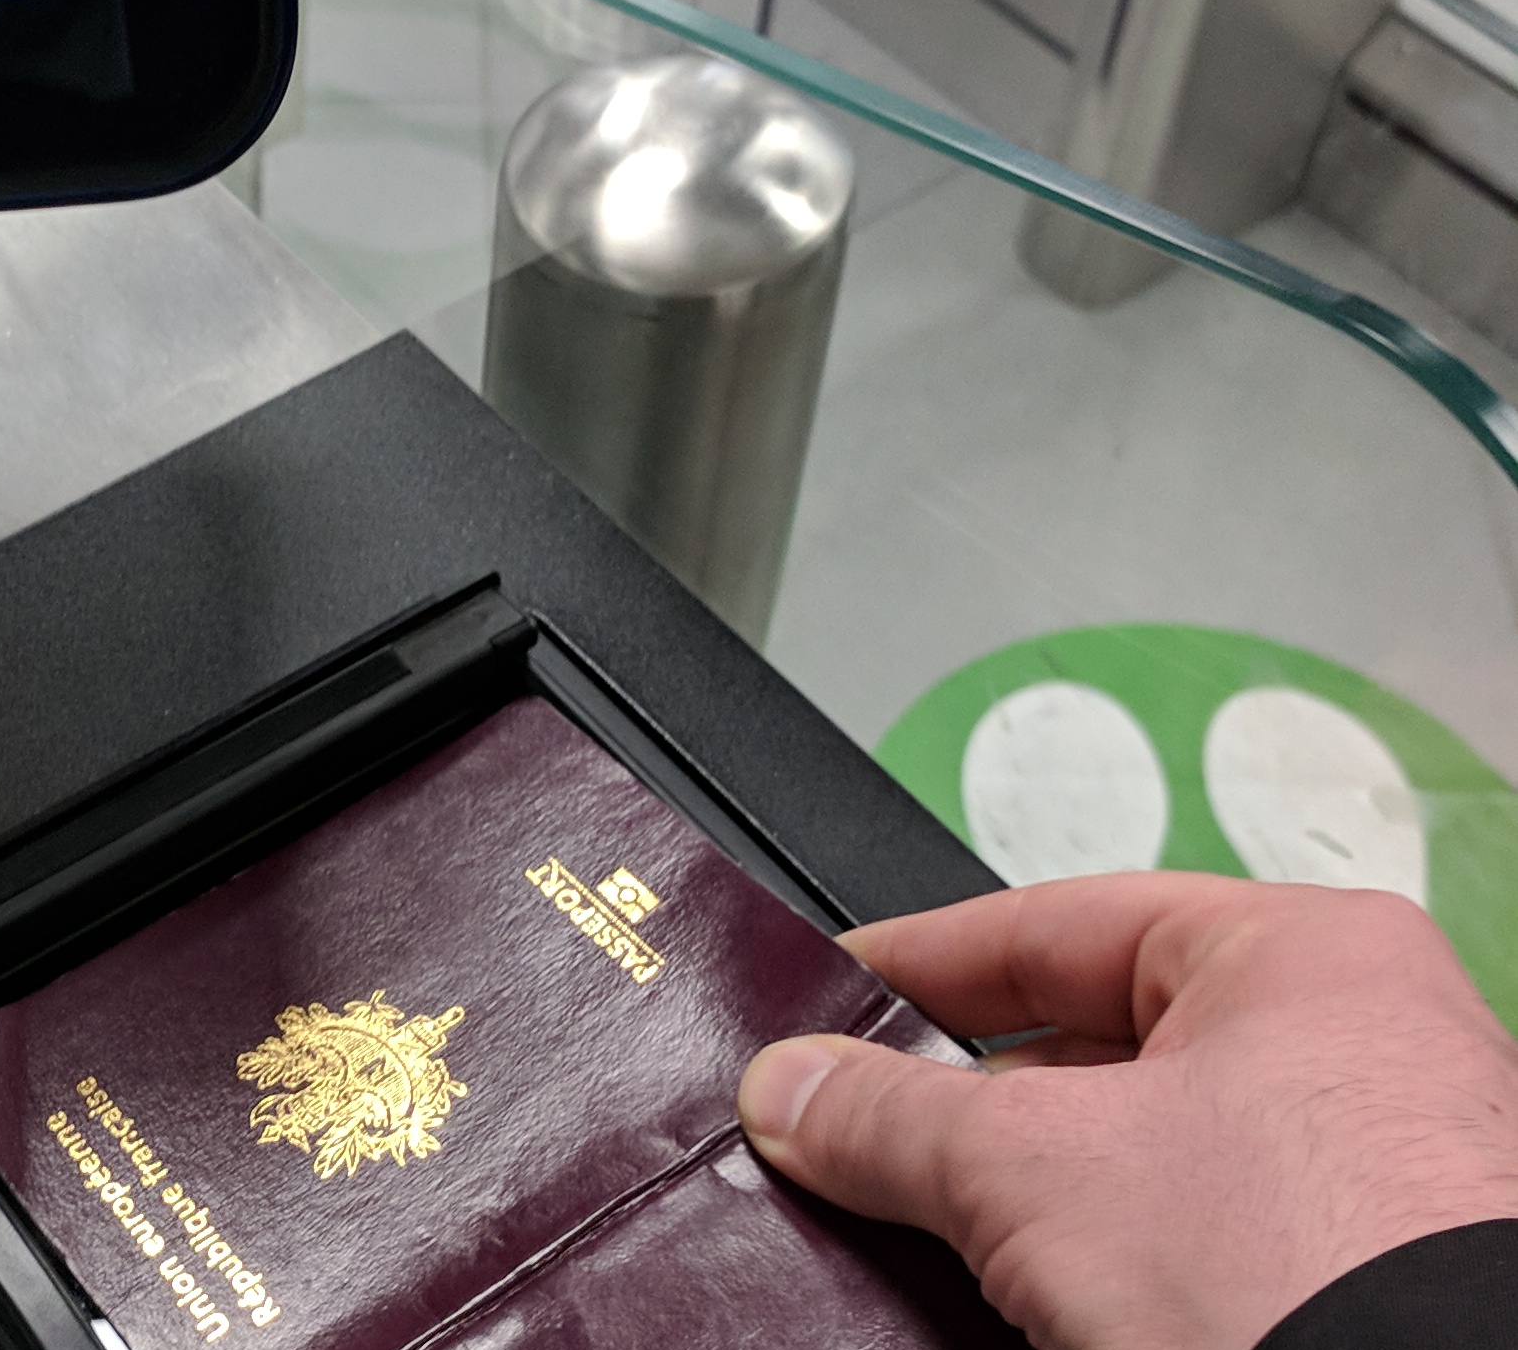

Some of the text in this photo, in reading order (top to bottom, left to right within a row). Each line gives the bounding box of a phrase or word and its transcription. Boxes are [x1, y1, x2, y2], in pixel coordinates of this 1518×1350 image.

[524, 857, 661, 984] PASSEPORT
[46, 1110, 230, 1343] Union européenne
[76, 1076, 281, 1328] République française
